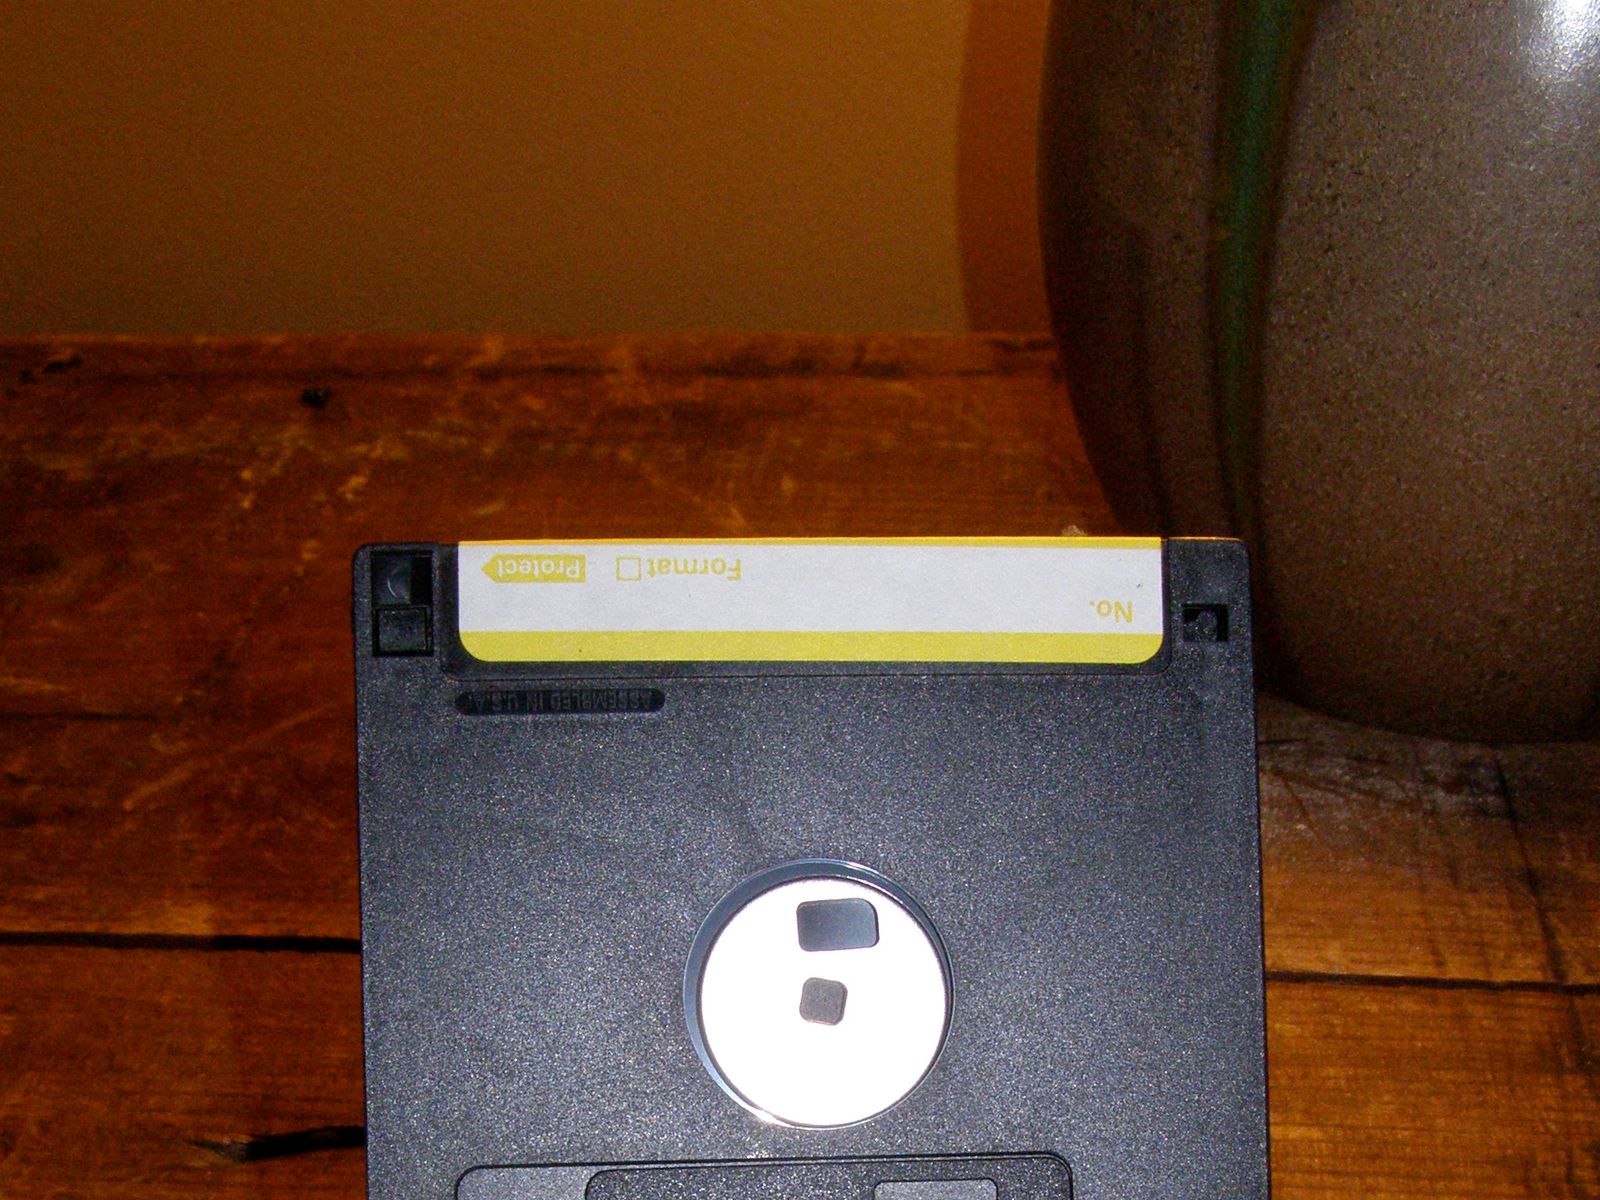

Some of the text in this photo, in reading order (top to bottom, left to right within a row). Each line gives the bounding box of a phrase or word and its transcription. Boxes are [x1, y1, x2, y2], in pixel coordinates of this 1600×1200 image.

[497, 555, 581, 579] Protect
[646, 557, 742, 582] Format
[1089, 600, 1134, 624] No.
